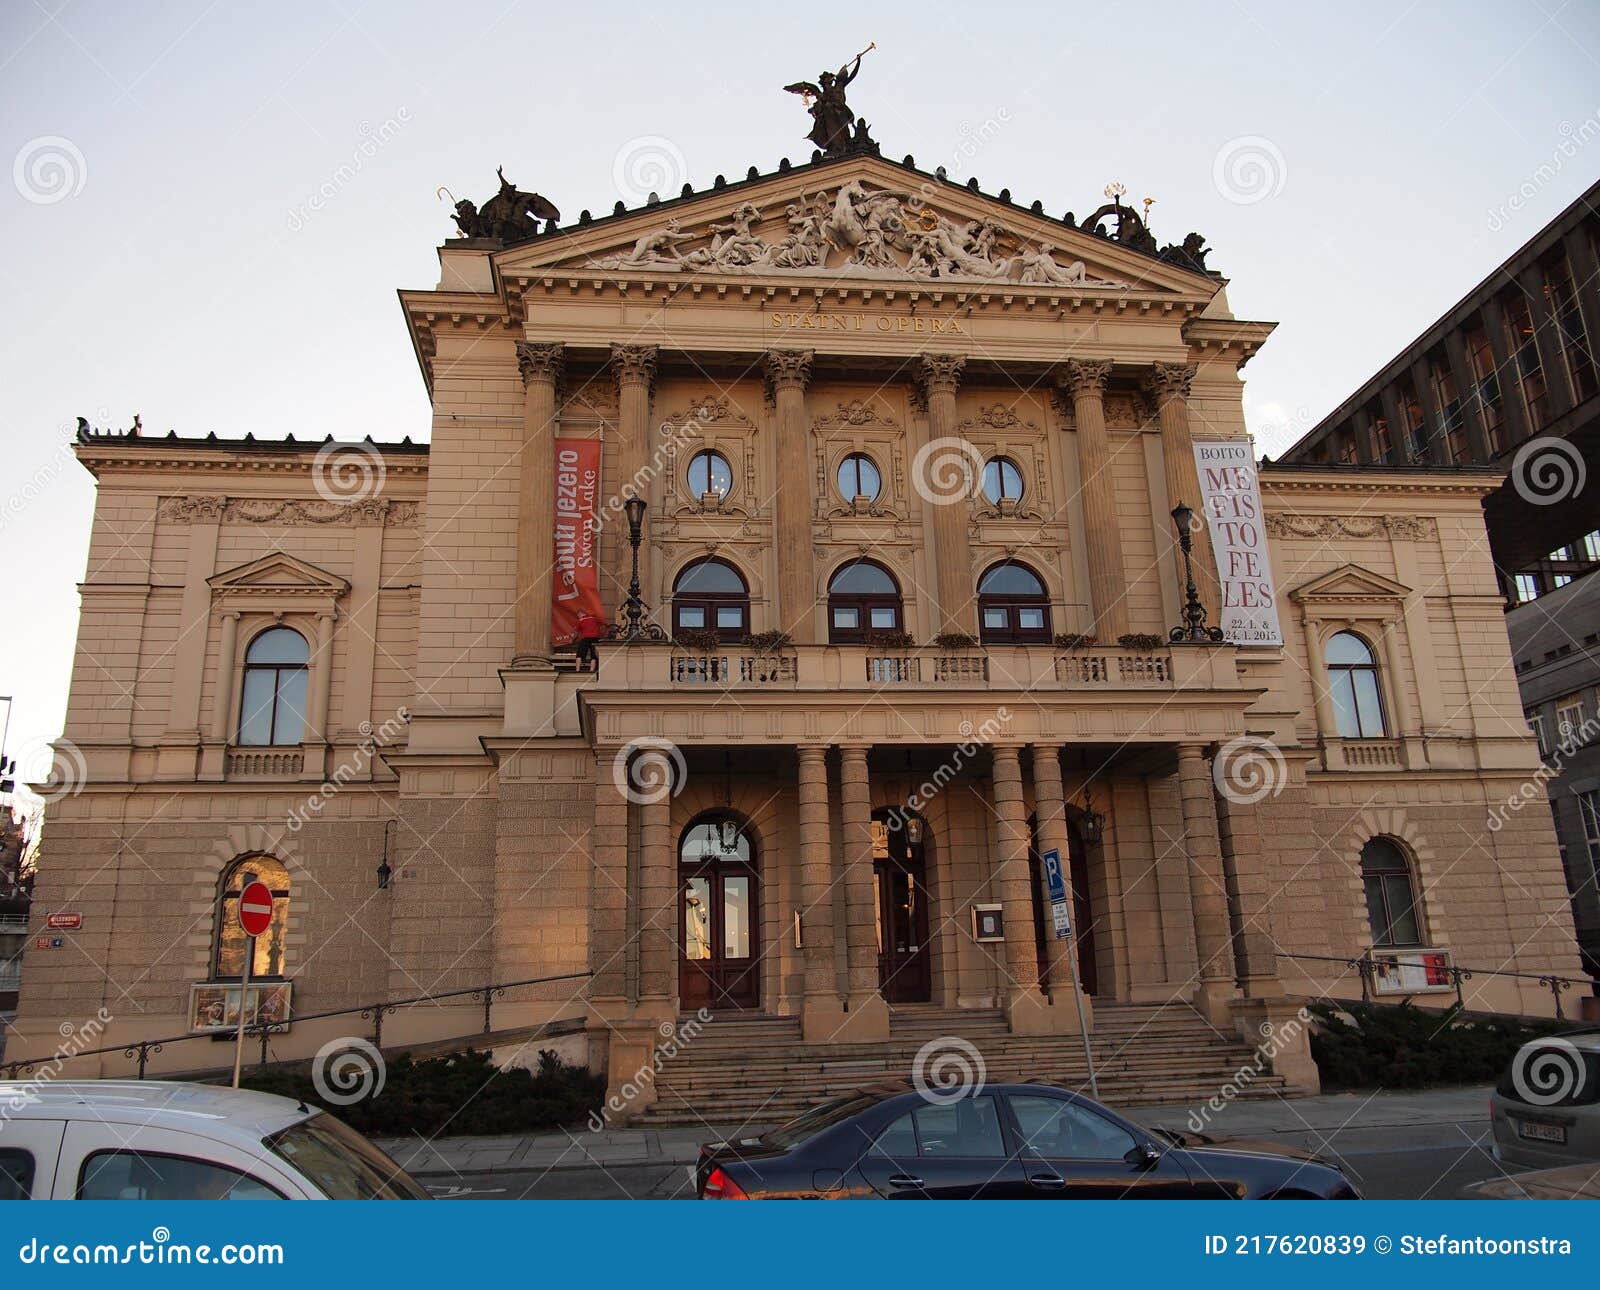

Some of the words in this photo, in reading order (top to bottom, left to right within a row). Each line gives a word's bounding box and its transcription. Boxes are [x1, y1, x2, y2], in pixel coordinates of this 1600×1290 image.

[876, 316, 965, 334] OPERA
[1200, 447, 1245, 460] BOITO
[578, 470, 596, 512] Lake
[1204, 467, 1251, 491] ME
[1209, 494, 1255, 519] FIS
[577, 519, 593, 568] Swan
[1218, 522, 1258, 548] TO
[1226, 551, 1261, 577] FE
[1223, 581, 1273, 608] LES
[1253, 631, 1277, 640] 2015
[1046, 857, 1057, 886] P
